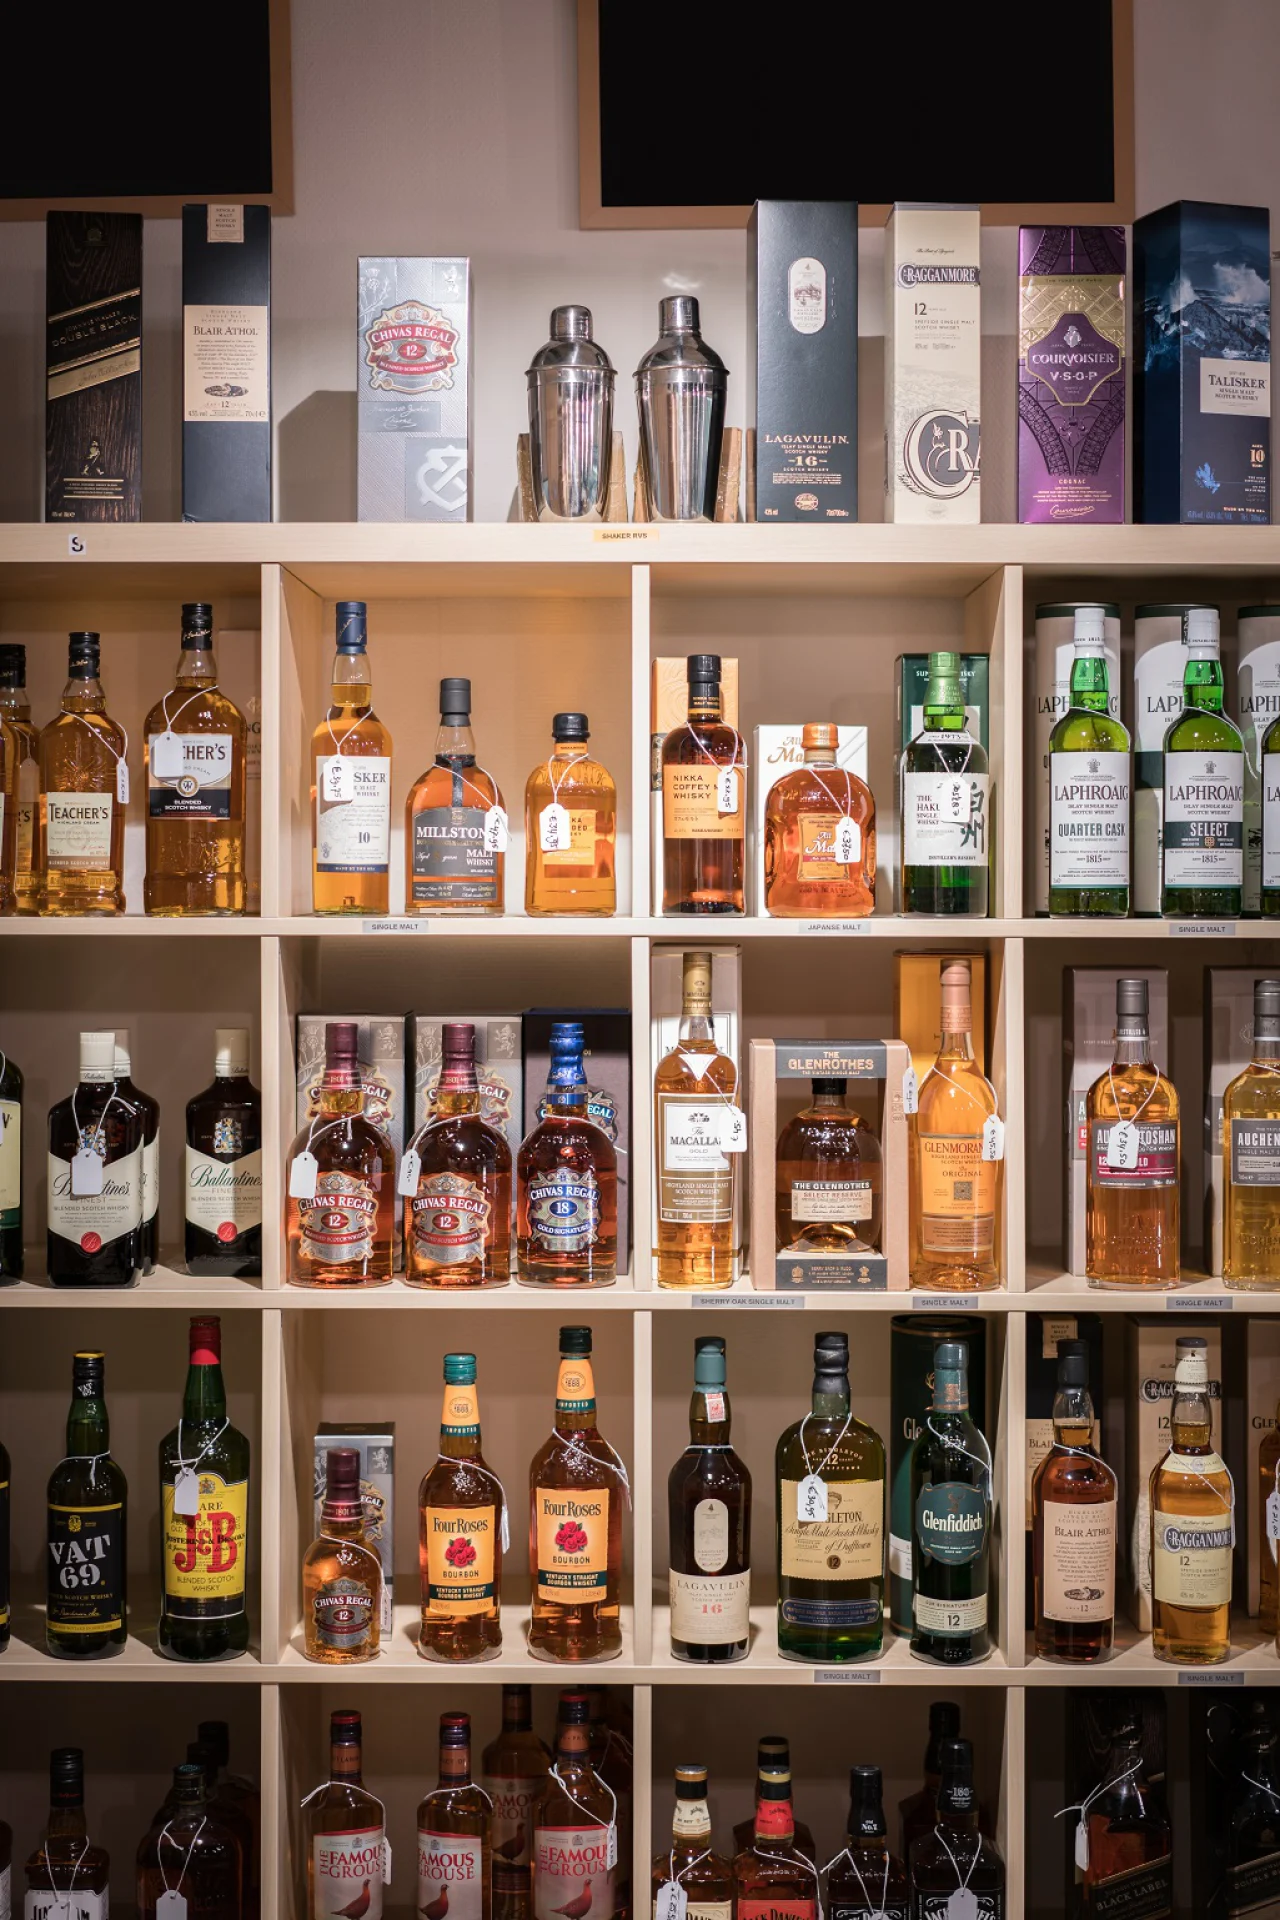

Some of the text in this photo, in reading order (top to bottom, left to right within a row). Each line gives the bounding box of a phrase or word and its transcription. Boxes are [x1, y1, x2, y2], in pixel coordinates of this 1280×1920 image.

[899, 264, 976, 288] CRAGGANMORE
[914, 302, 927, 315] 12
[52, 314, 137, 347] DOUBLE BLACK
[193, 326, 258, 336] BLAIR ATHOL
[371, 326, 453, 343] CHIVAS REGAL
[406, 345, 418, 356] 12
[1032, 352, 1114, 367] COURVOISIER
[1208, 374, 1266, 388] TALISKER
[1250, 449, 1265, 462] 10
[49, 803, 109, 822] TEACHER'S
[1059, 823, 1126, 837] QUARTER CASK
[1190, 823, 1228, 837] SELECT
[358, 832, 370, 843] 10
[466, 849, 493, 857] MALT
[466, 858, 494, 866] WHISKY
[788, 1059, 874, 1070] GLENROTHES
[670, 1137, 721, 1146] MACALLA
[812, 1182, 870, 1190] GLENROTHES
[530, 1187, 598, 1199] CHIVAS REGAL
[300, 1196, 374, 1212] CHIVAS REGAL
[413, 1197, 485, 1214] CHIVAS REGAL
[556, 1202, 569, 1213] 18
[329, 1214, 342, 1226] 12
[440, 1215, 452, 1227] 12
[1159, 1417, 1170, 1429] 12
[543, 1499, 601, 1517] Four Roses
[434, 1517, 488, 1534] Four Roses
[923, 1509, 982, 1532] Glenfiddich
[1055, 1526, 1084, 1537] BLAIR
[49, 1534, 110, 1564] VAT
[1180, 1556, 1190, 1565] 12
[177, 1576, 206, 1584] BLENDED
[443, 1570, 479, 1578] BOURBON
[314, 1597, 372, 1607] CHIVAS REGAL
[702, 1604, 722, 1613] 16
[338, 1611, 349, 1620] 12
[948, 1615, 960, 1625] 12
[1097, 1880, 1168, 1911] BLACK LABEL
